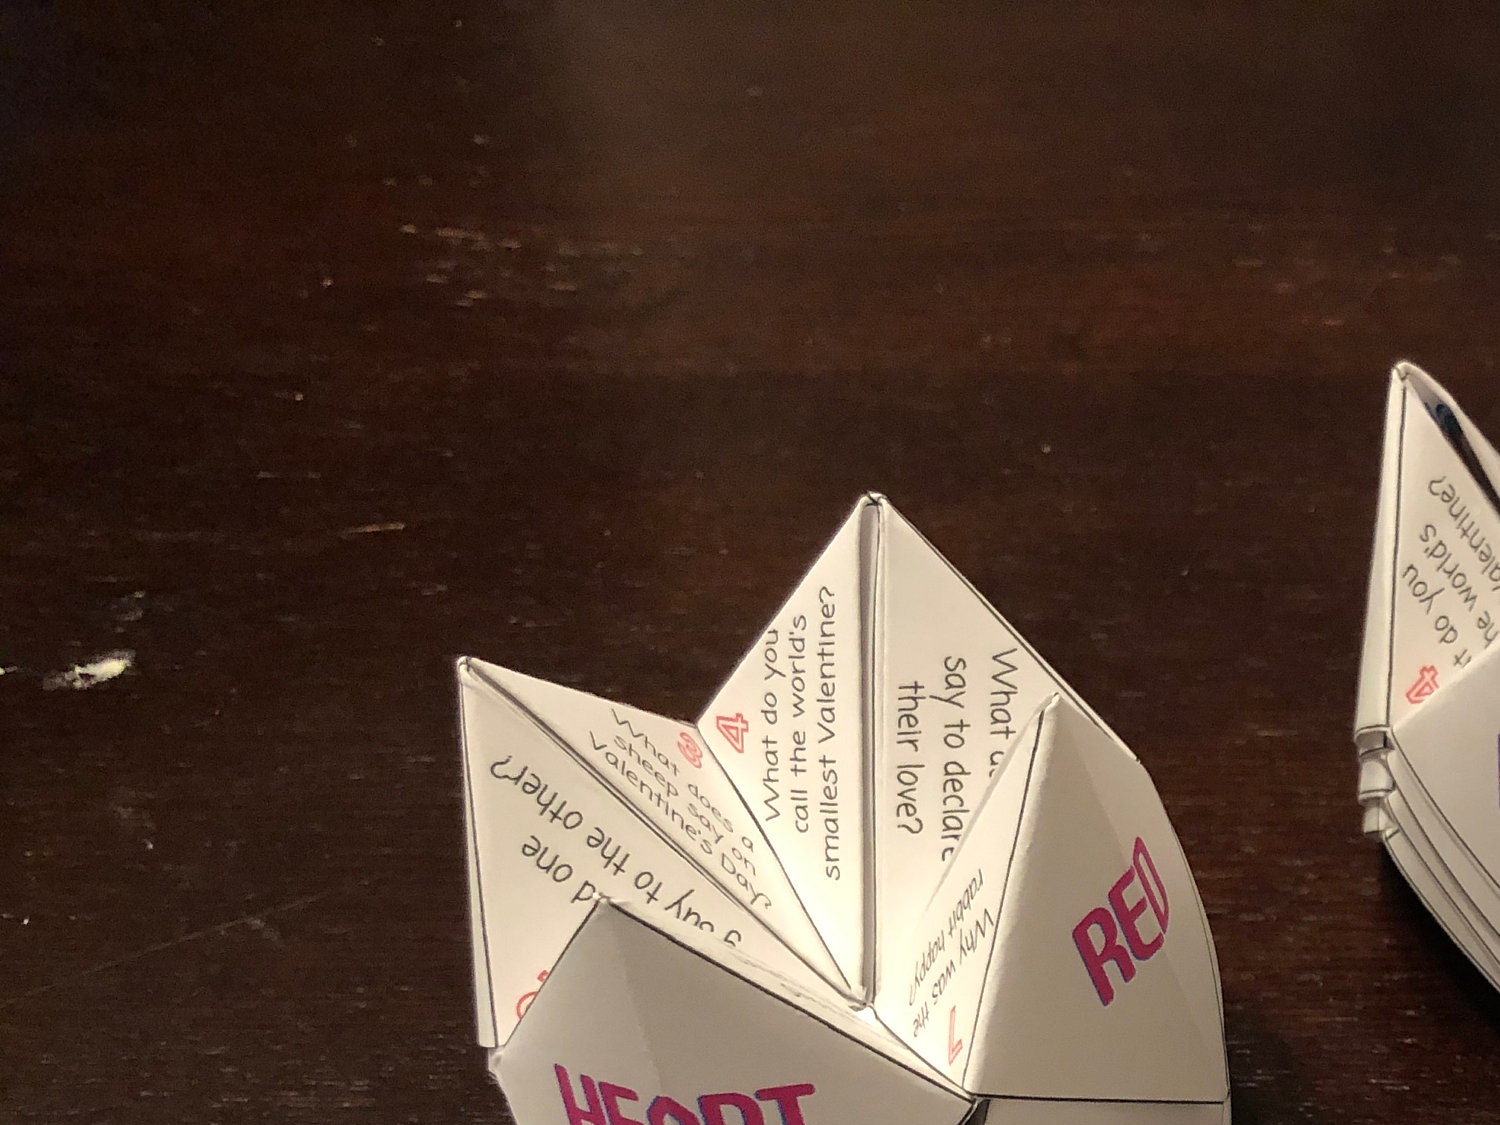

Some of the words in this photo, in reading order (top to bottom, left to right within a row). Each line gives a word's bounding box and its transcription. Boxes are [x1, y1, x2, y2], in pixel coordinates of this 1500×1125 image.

[1402, 563, 1445, 614] you
[1419, 524, 1478, 613] world's
[764, 629, 787, 682] you
[1434, 615, 1459, 644] do
[1476, 610, 1500, 650] he
[788, 614, 807, 719] world's
[816, 586, 836, 744] Valentine?
[929, 656, 968, 709] say
[761, 692, 778, 726] do
[897, 680, 925, 753] their
[989, 648, 1018, 740] What
[677, 732, 703, 768] 3
[716, 713, 749, 754] 4
[790, 730, 808, 778] the
[943, 719, 971, 749] to
[490, 755, 583, 829] other?
[589, 730, 712, 855] Valentine's
[611, 708, 680, 777] What
[687, 783, 734, 833] does
[742, 837, 753, 853] a
[762, 735, 781, 821] What
[896, 764, 925, 834] love?
[614, 735, 679, 798] sheep
[688, 803, 724, 843] say
[732, 848, 757, 876] on
[790, 789, 809, 833] call
[819, 754, 840, 881] smallest
[522, 836, 573, 882] one
[587, 827, 630, 876] the
[634, 872, 662, 904] to
[948, 868, 984, 938] rabbit
[959, 908, 994, 965] Why
[1071, 837, 1170, 1007] RED
[931, 959, 956, 1005] was
[913, 1001, 929, 1038] the
